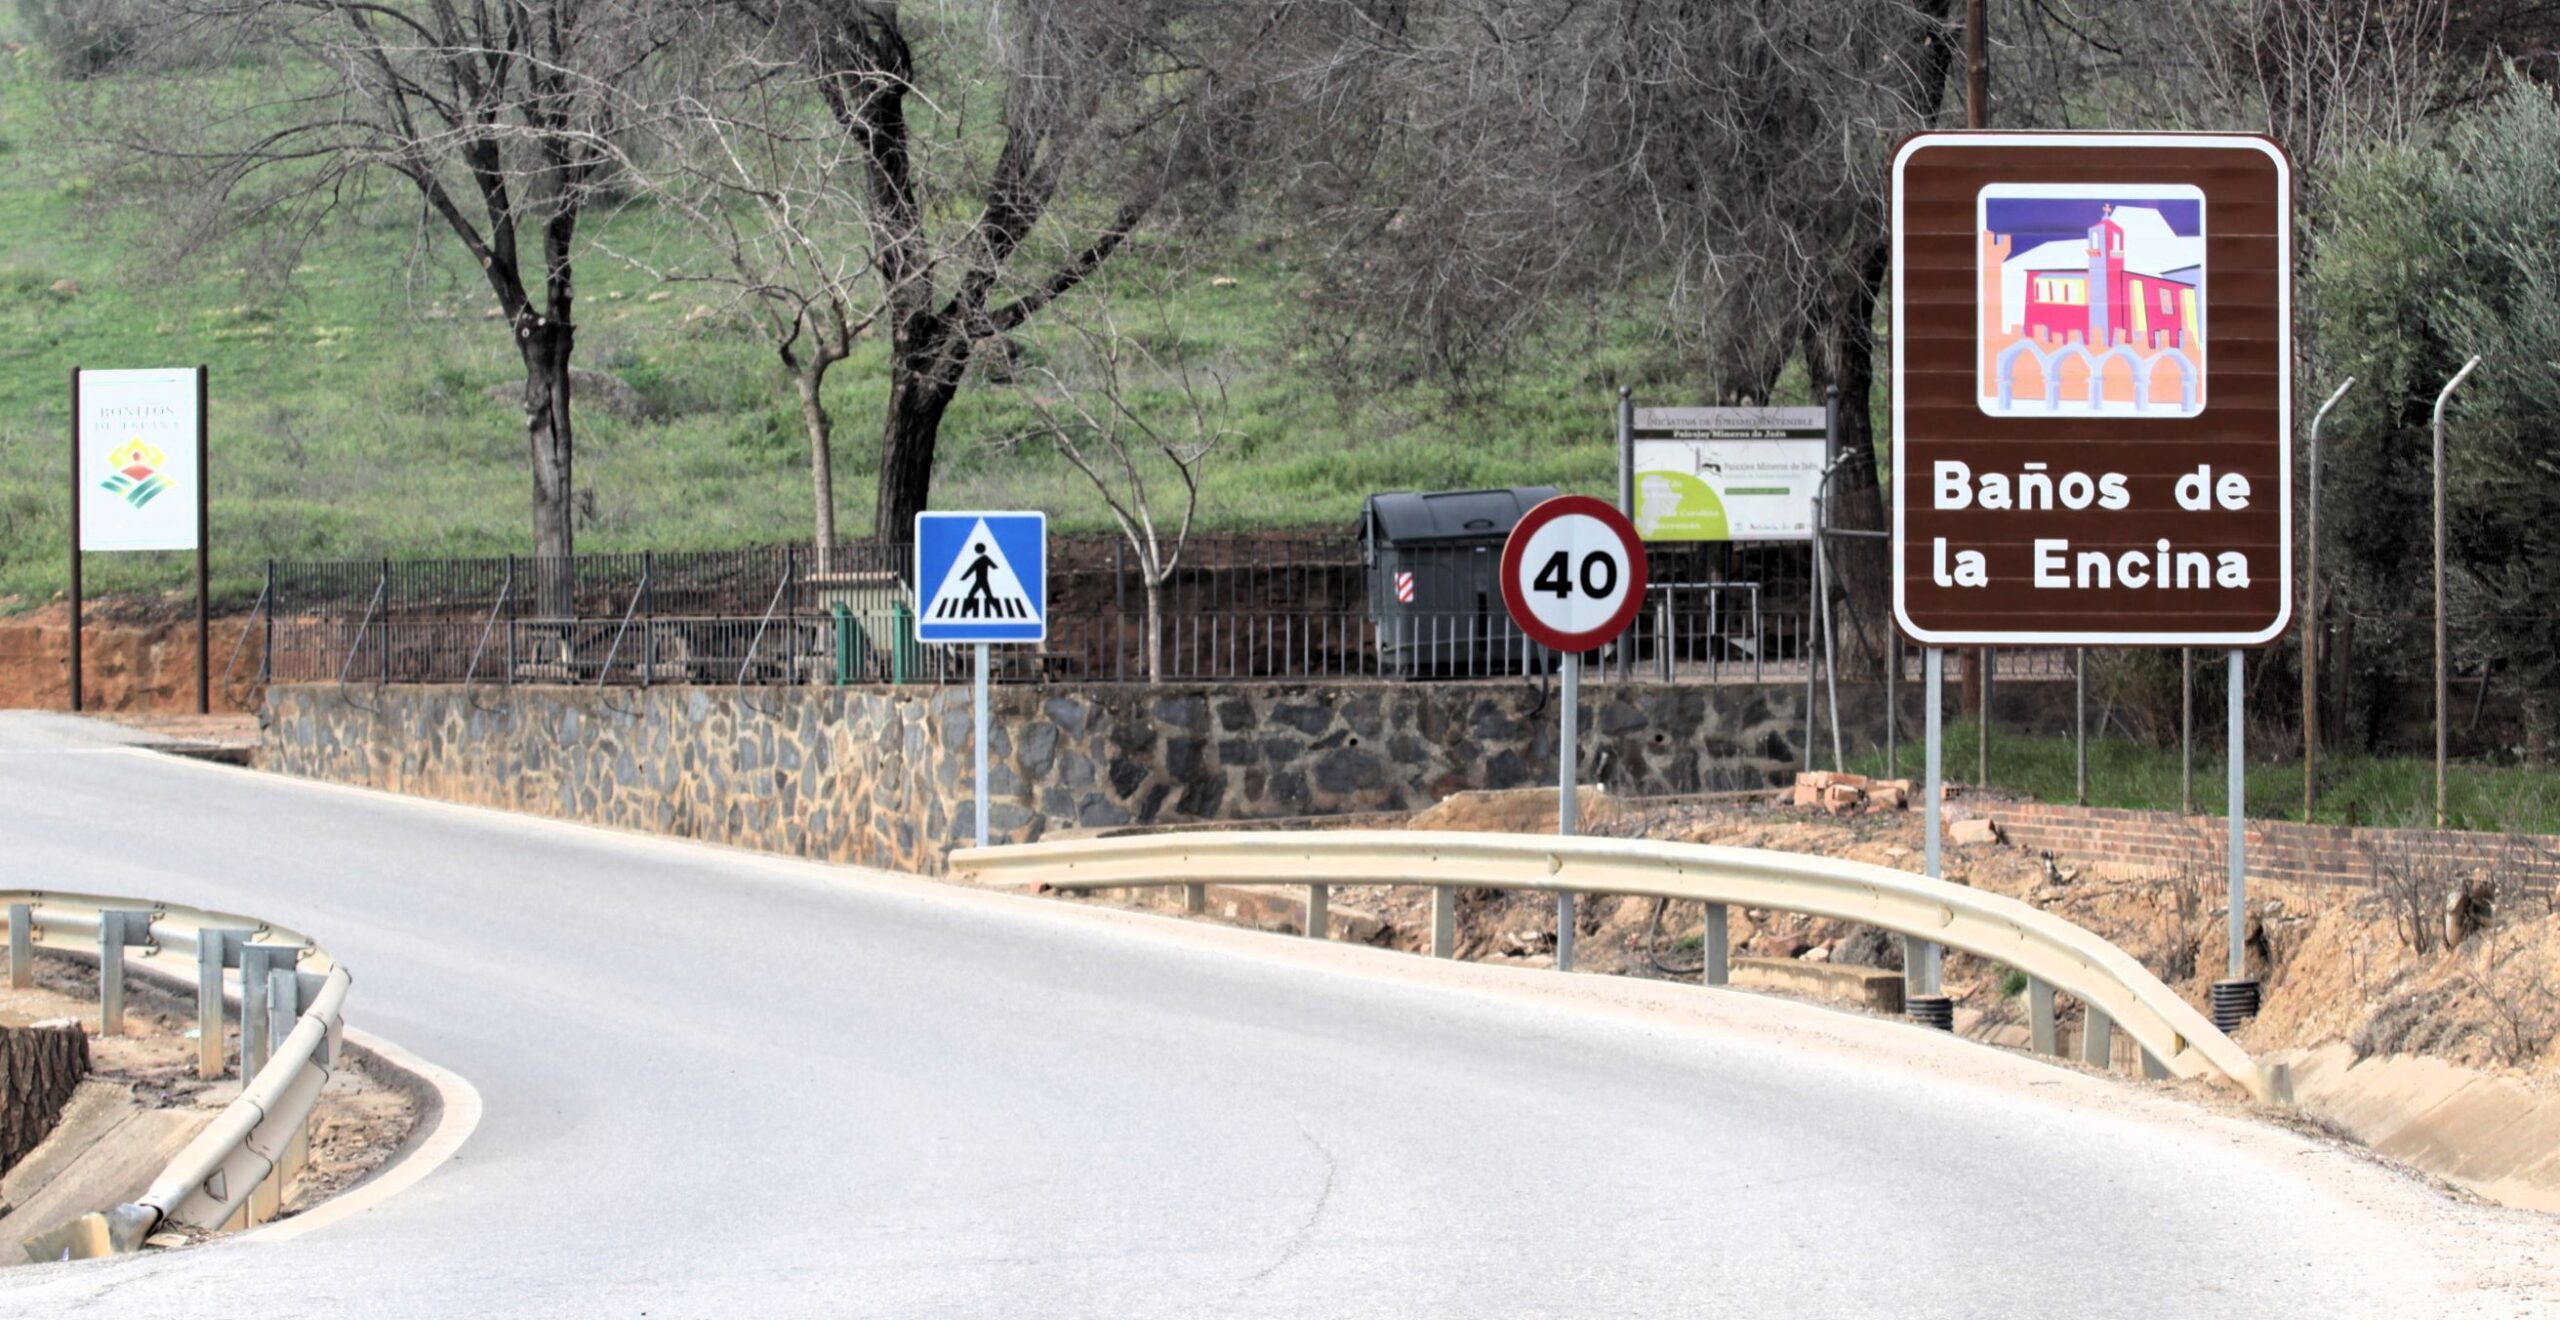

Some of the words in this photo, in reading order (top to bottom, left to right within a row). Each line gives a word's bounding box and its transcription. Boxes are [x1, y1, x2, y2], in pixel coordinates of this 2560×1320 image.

[1934, 461, 2131, 510] Baños
[2174, 464, 2251, 511] de
[1533, 550, 1618, 600] 40
[1933, 537, 1989, 588] la
[2034, 538, 2251, 589] Encina
